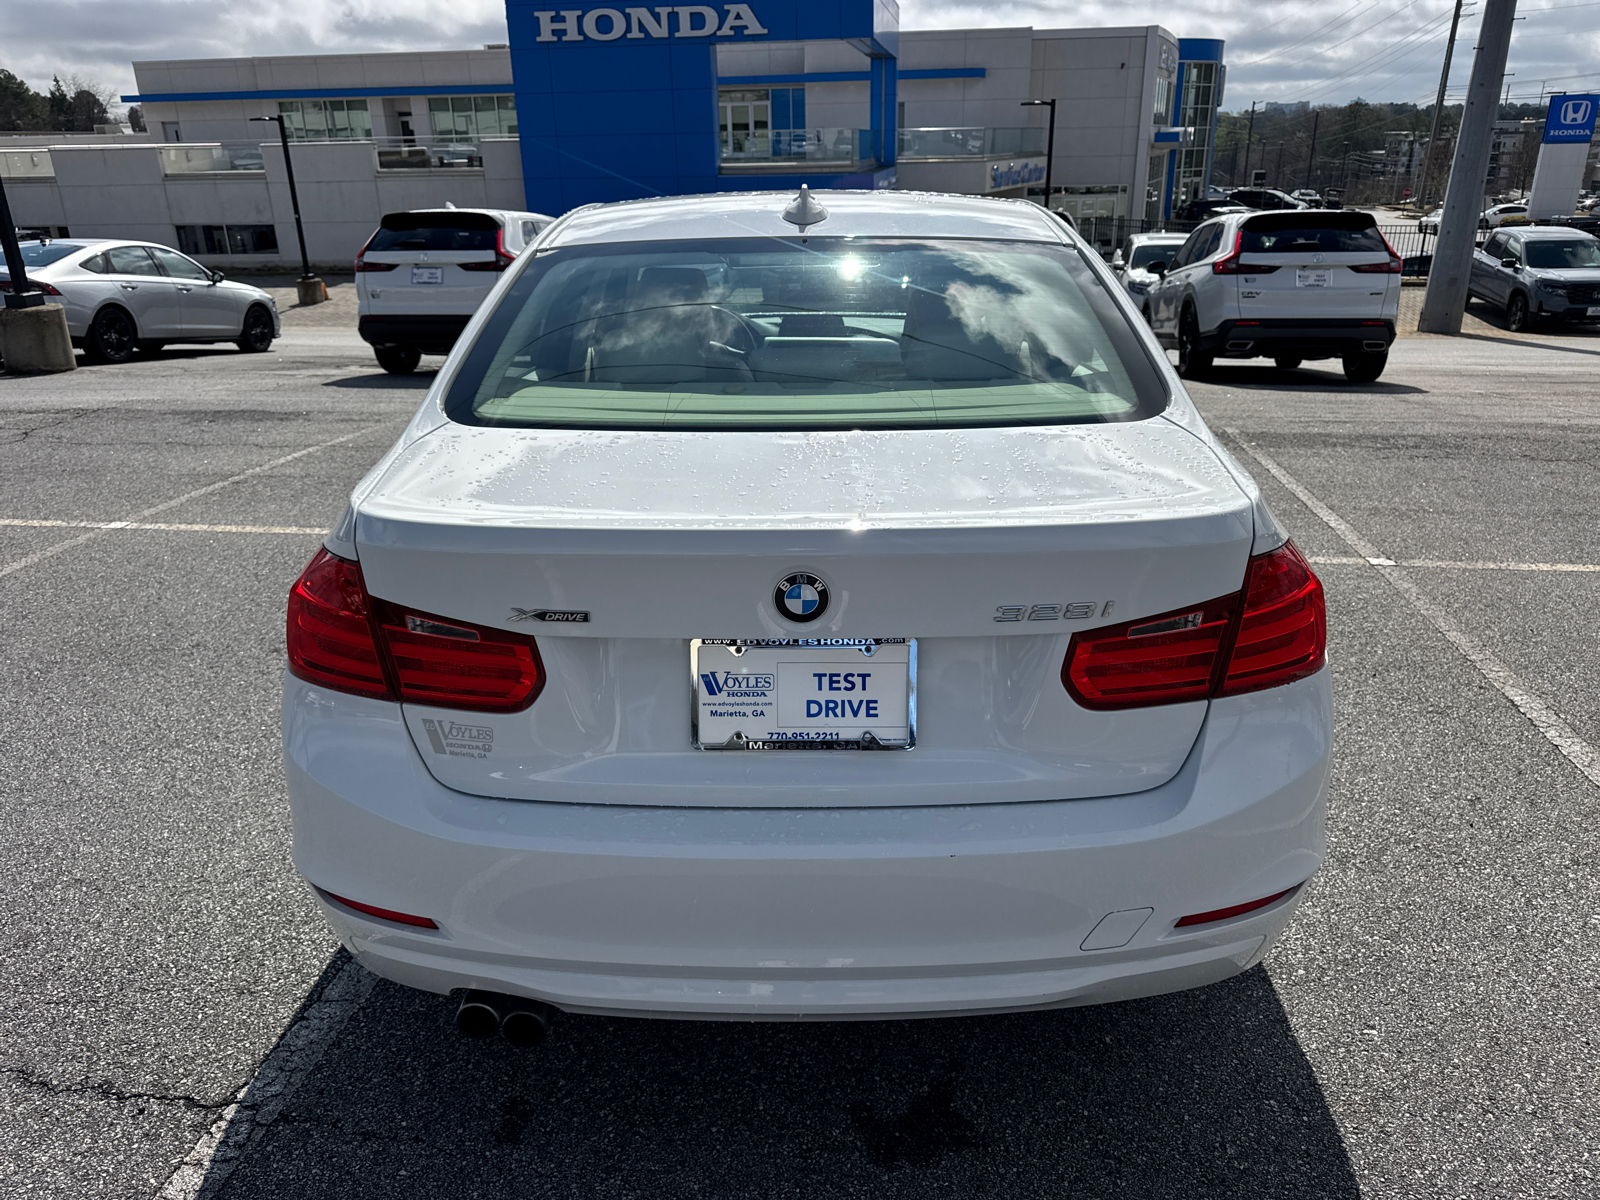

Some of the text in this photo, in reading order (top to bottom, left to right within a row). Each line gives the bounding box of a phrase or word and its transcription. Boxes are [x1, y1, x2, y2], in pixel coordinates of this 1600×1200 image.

[533, 3, 768, 42] HONDA
[779, 574, 825, 592] BMW
[993, 600, 1115, 623] 328i
[709, 671, 772, 694] VOYLES
[812, 672, 872, 692] TEST
[710, 709, 766, 718] Marietta, GA
[805, 699, 879, 718] DRIVE
[436, 719, 493, 742] VOYLES
[767, 731, 840, 740] 770-951-2211
[445, 741, 483, 751] HONDA
[449, 750, 477, 759] Marietta,
[749, 741, 858, 750] Marietta, GA
